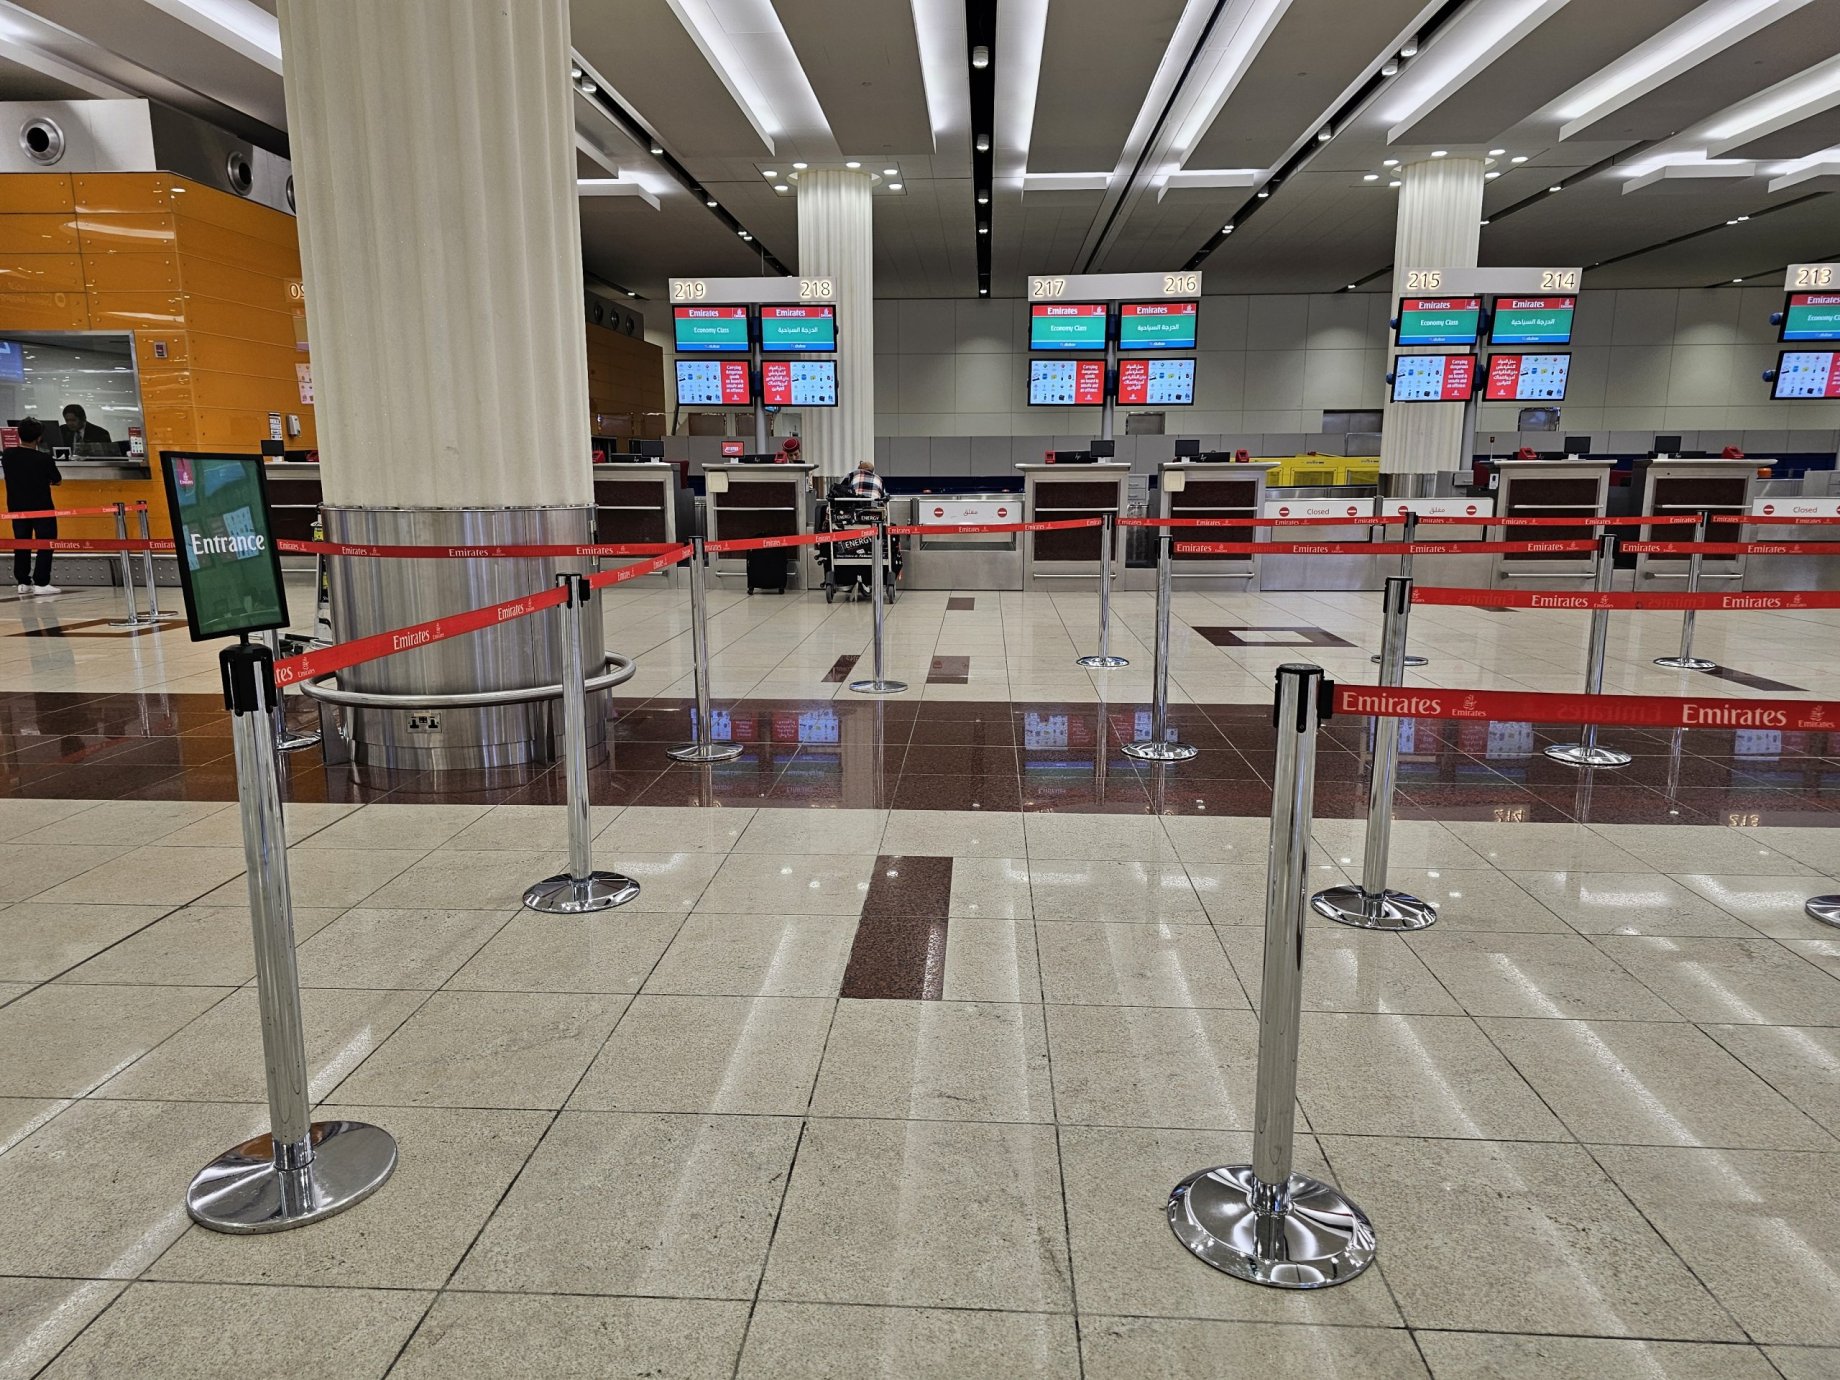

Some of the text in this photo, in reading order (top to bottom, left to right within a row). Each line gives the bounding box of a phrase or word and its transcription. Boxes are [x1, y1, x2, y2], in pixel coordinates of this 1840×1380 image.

[1408, 273, 1441, 288] 215
[1542, 273, 1575, 288] 214
[1798, 269, 1832, 285] 213
[1034, 280, 1064, 296] 217
[1165, 276, 1196, 292] 216
[674, 282, 704, 298] 219
[800, 281, 831, 297] 218
[1419, 301, 1450, 309] Emirates
[1512, 300, 1545, 309] Emirates
[689, 309, 719, 317] Emirates
[776, 309, 805, 317] Emirates
[1047, 307, 1078, 315] Emirates
[1136, 306, 1168, 314] Emirates
[1807, 314, 1833, 322] Economy
[1429, 506, 1445, 514] مغلق
[1712, 515, 1739, 523] Emirates
[50, 541, 80, 549] Emirates
[150, 541, 175, 549] Emirat
[191, 533, 265, 555] Entrance
[1176, 543, 1212, 552] Emirates
[1293, 544, 1328, 553] Emirates
[1410, 544, 1446, 553] Emirates
[1527, 543, 1564, 552] Emirates
[1622, 543, 1660, 552] Emirates
[1747, 544, 1786, 553] Emirates
[342, 546, 367, 556] Emirates
[449, 548, 488, 557] Emirates
[576, 546, 613, 555] Emirates
[1531, 595, 1588, 607] Emirates
[1722, 596, 1781, 608] Emirates
[497, 603, 524, 620] Emirates
[392, 629, 430, 650] Emirates
[1342, 691, 1441, 715] Emirates
[1452, 708, 1487, 717] Emirates
[1682, 703, 1787, 727] Emirates
[1798, 719, 1835, 728] Emirates
